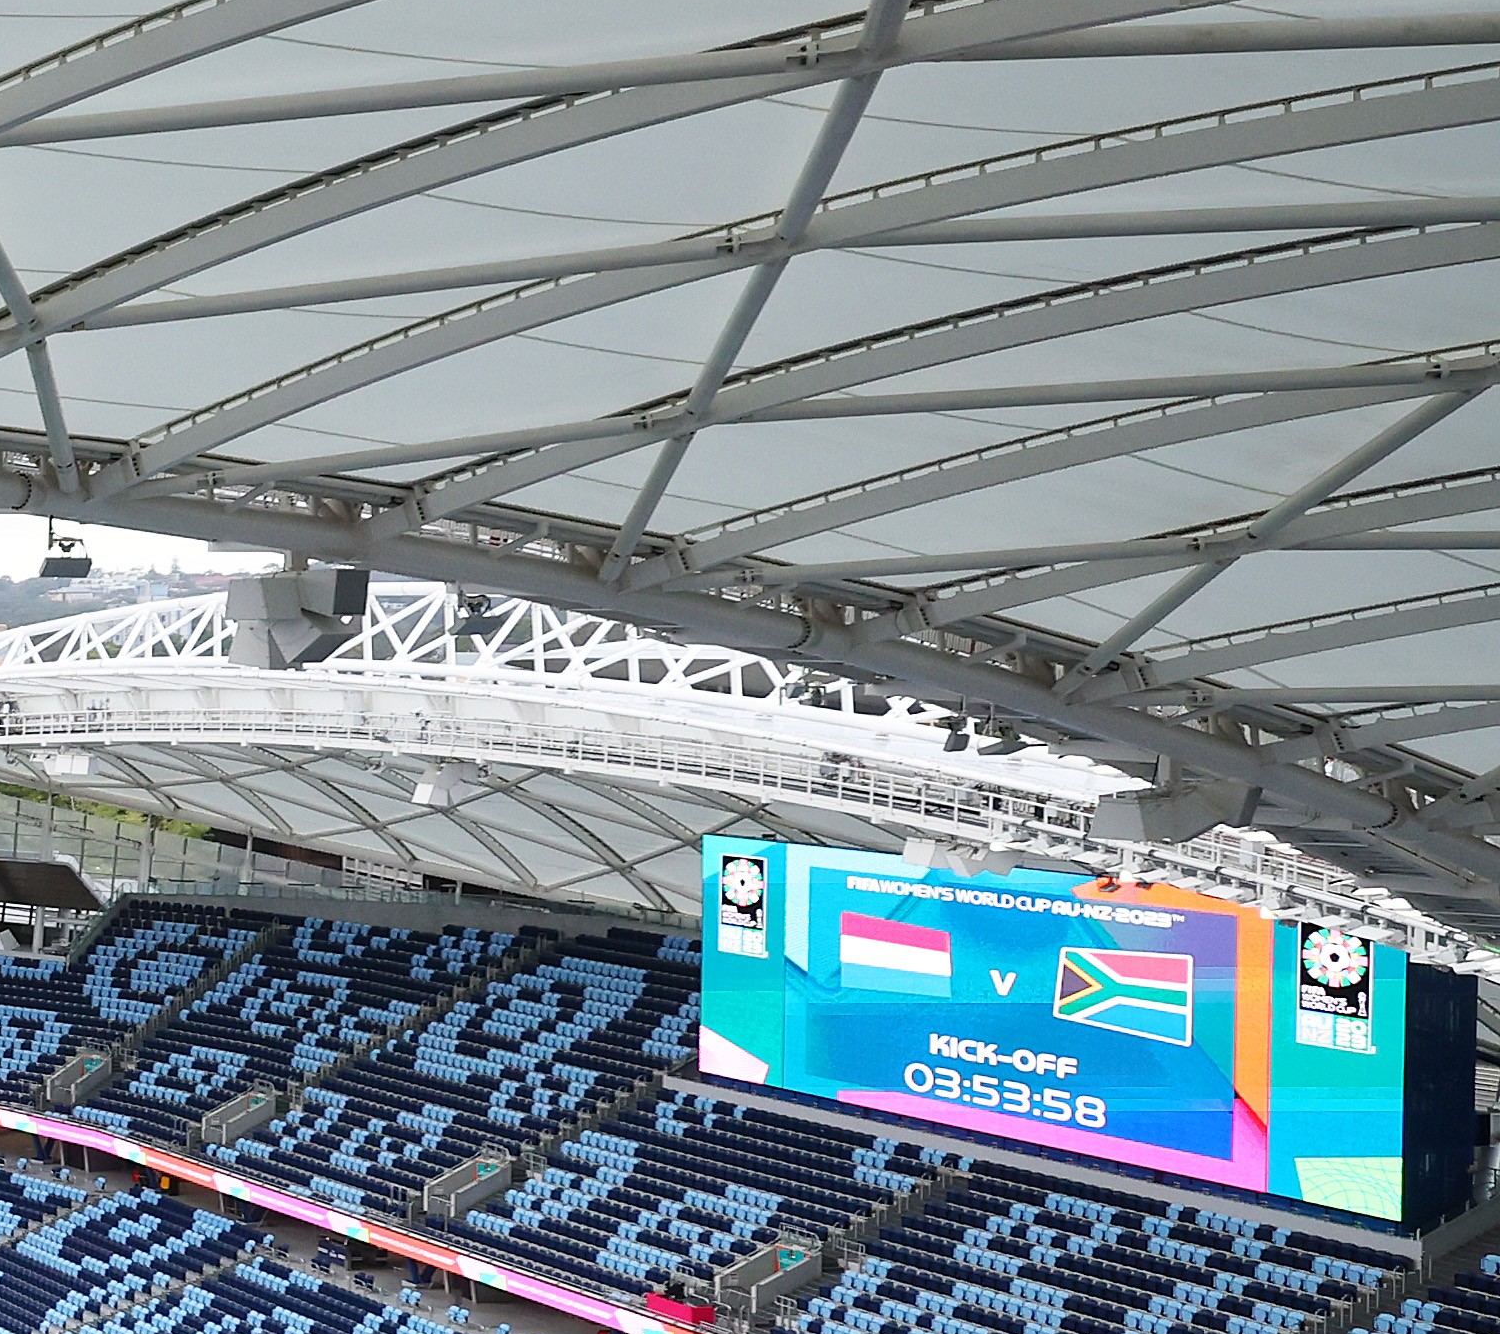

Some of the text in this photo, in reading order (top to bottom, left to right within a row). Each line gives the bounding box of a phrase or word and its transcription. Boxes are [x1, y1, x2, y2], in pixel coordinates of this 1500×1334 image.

[847, 875, 881, 893] FIFA
[880, 881, 955, 902] WOMEN'S
[956, 889, 1015, 910] WORLD
[1016, 895, 1052, 914] CUP
[1336, 1006, 1357, 1015] CUP
[929, 1033, 1079, 1079] KICK-OFF
[904, 1062, 1107, 1129] 03:53:58
